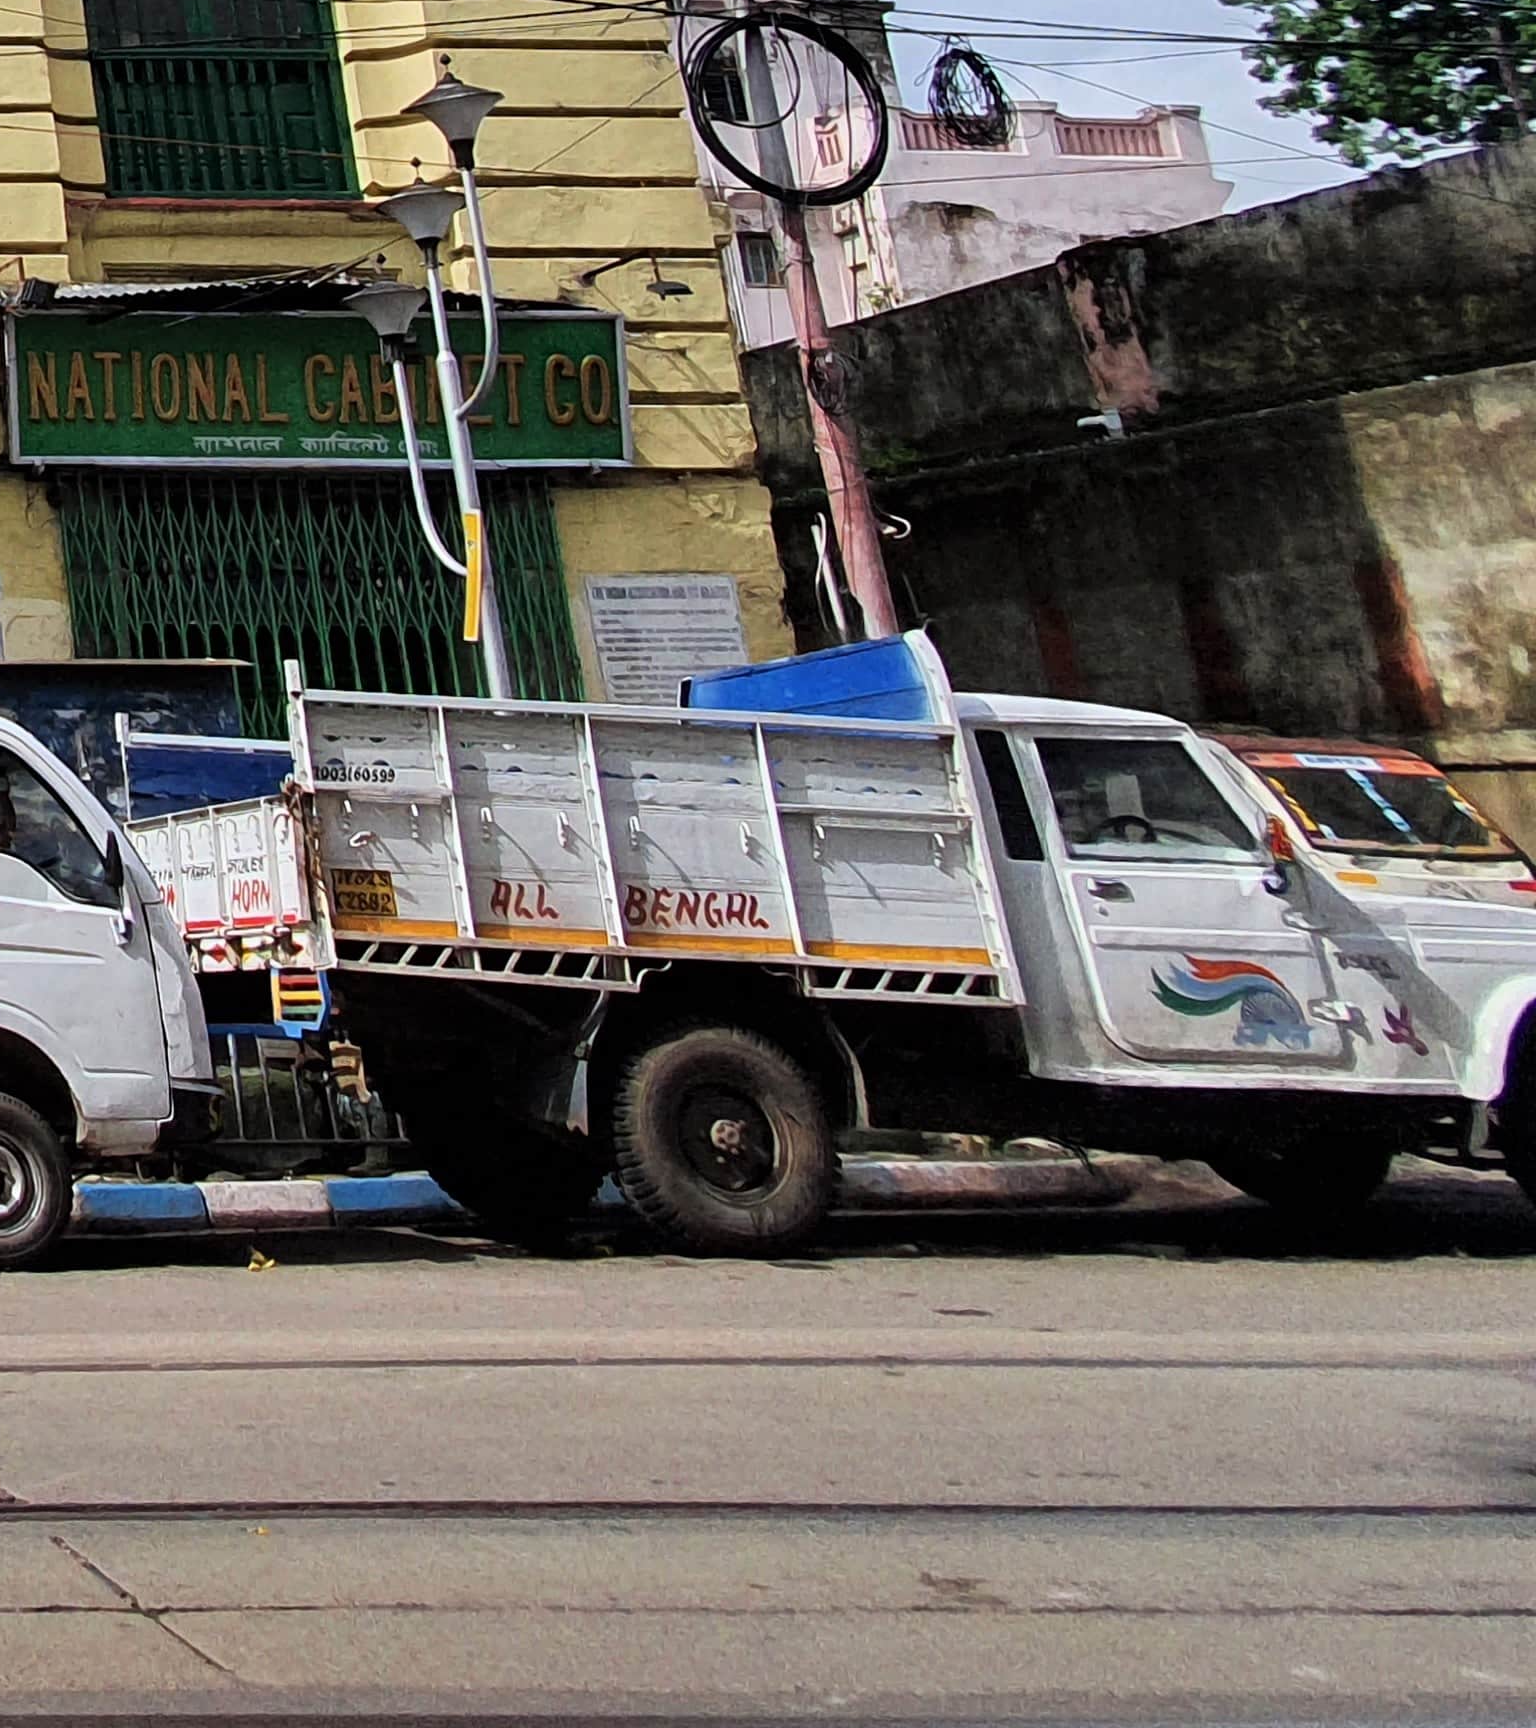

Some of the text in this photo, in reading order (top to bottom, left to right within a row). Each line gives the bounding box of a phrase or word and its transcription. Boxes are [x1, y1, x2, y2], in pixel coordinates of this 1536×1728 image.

[27, 352, 289, 422] NATIONAL
[192, 436, 284, 454] ন্যাশনাল
[299, 431, 390, 455] ক্যাবিনেট
[231, 879, 272, 913] HORN
[490, 878, 769, 930] ALL BENGAL
